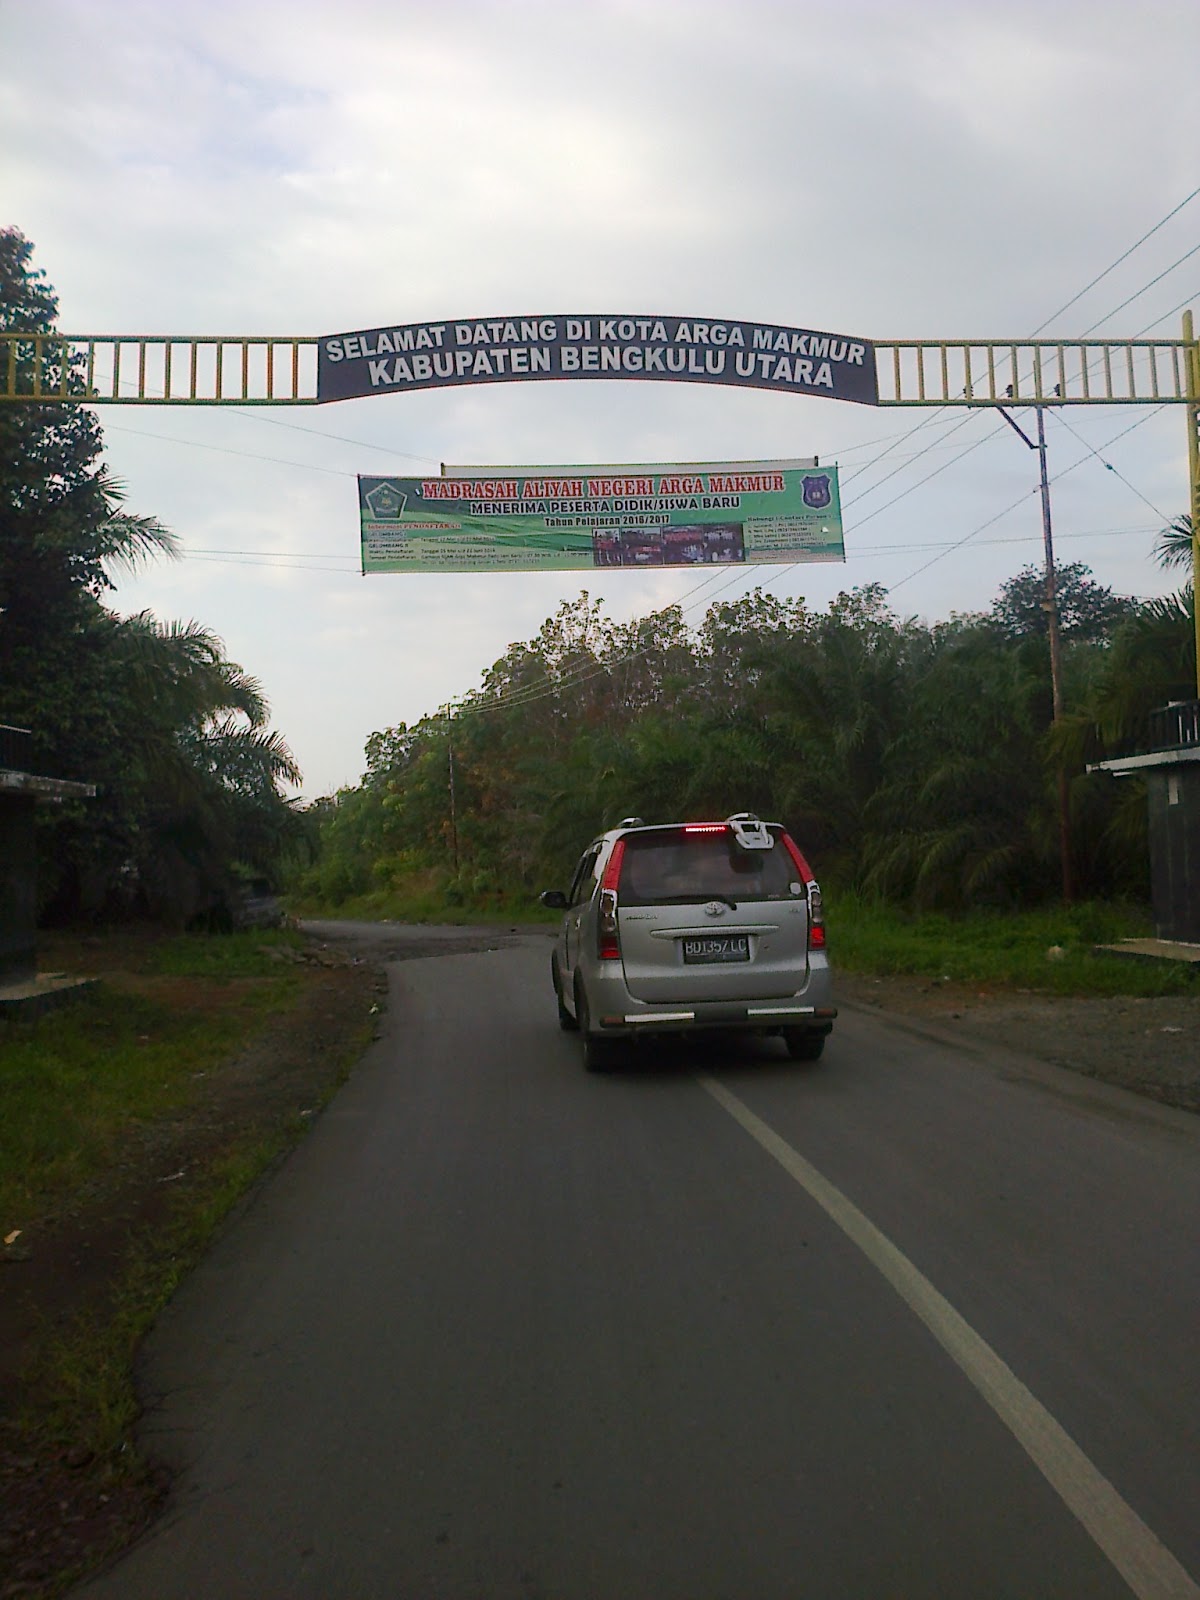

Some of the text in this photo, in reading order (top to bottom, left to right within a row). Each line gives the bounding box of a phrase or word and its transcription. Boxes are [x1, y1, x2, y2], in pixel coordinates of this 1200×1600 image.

[325, 319, 866, 366] SELAMAT DATANG DI KOTA ARGA MAKMUR
[368, 346, 834, 389] KABUPATEN BENGKULU UTARA
[422, 474, 785, 499] MADRASAH ALIYAH NEGERI ARGA MAKMUR
[471, 496, 740, 514] MENERIMA PESERTA DIDIK/SISWA BARU
[545, 517, 573, 526] Tahun
[576, 516, 620, 527] Pelajaran
